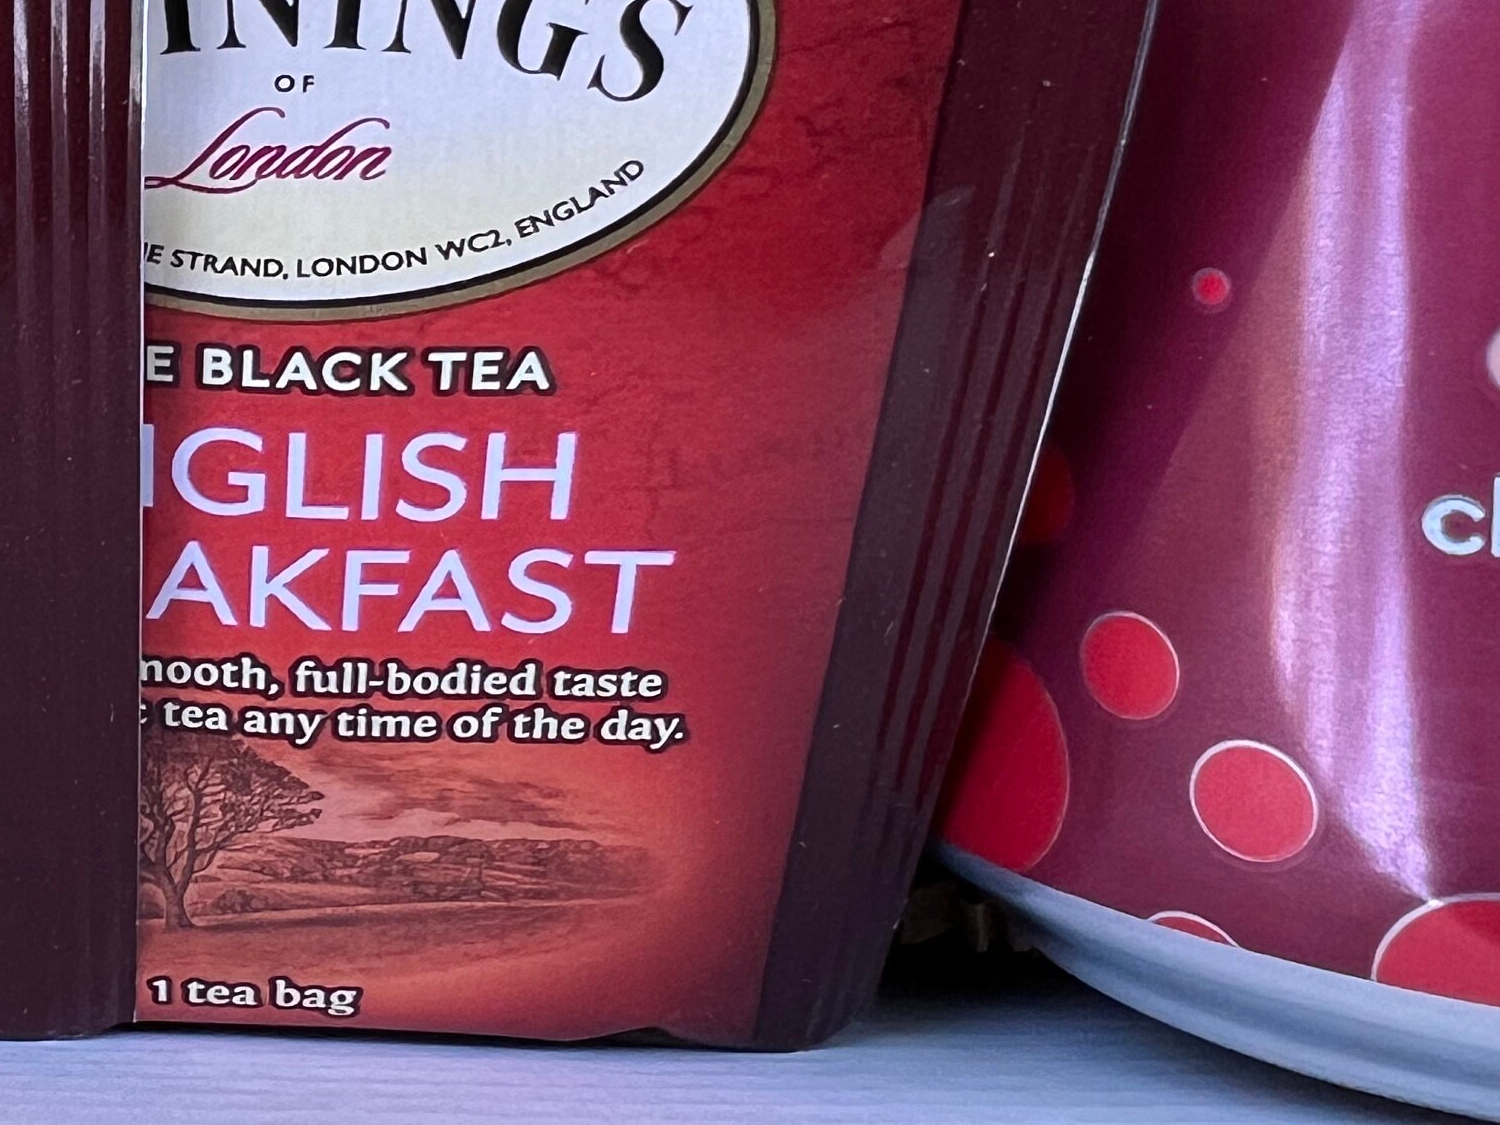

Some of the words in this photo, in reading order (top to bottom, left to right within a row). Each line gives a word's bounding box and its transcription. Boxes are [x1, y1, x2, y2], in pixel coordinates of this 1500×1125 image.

[274, 74, 316, 93] OF
[143, 106, 392, 195] London
[296, 247, 427, 278] LONDON
[436, 229, 512, 258] WC2,
[514, 159, 645, 239] ENGLAND
[202, 348, 408, 392] BLACK
[428, 350, 551, 391] TEA
[1421, 473, 1500, 557] c
[294, 659, 536, 696] full-bodied
[553, 669, 663, 698] taste
[163, 702, 229, 732] tea
[243, 710, 322, 745] any
[337, 707, 437, 738] time
[452, 705, 506, 739] of
[512, 707, 586, 742] the
[599, 709, 685, 752] day.
[152, 979, 168, 1002] 1
[186, 980, 257, 1006] tea
[275, 979, 357, 1016] bag
